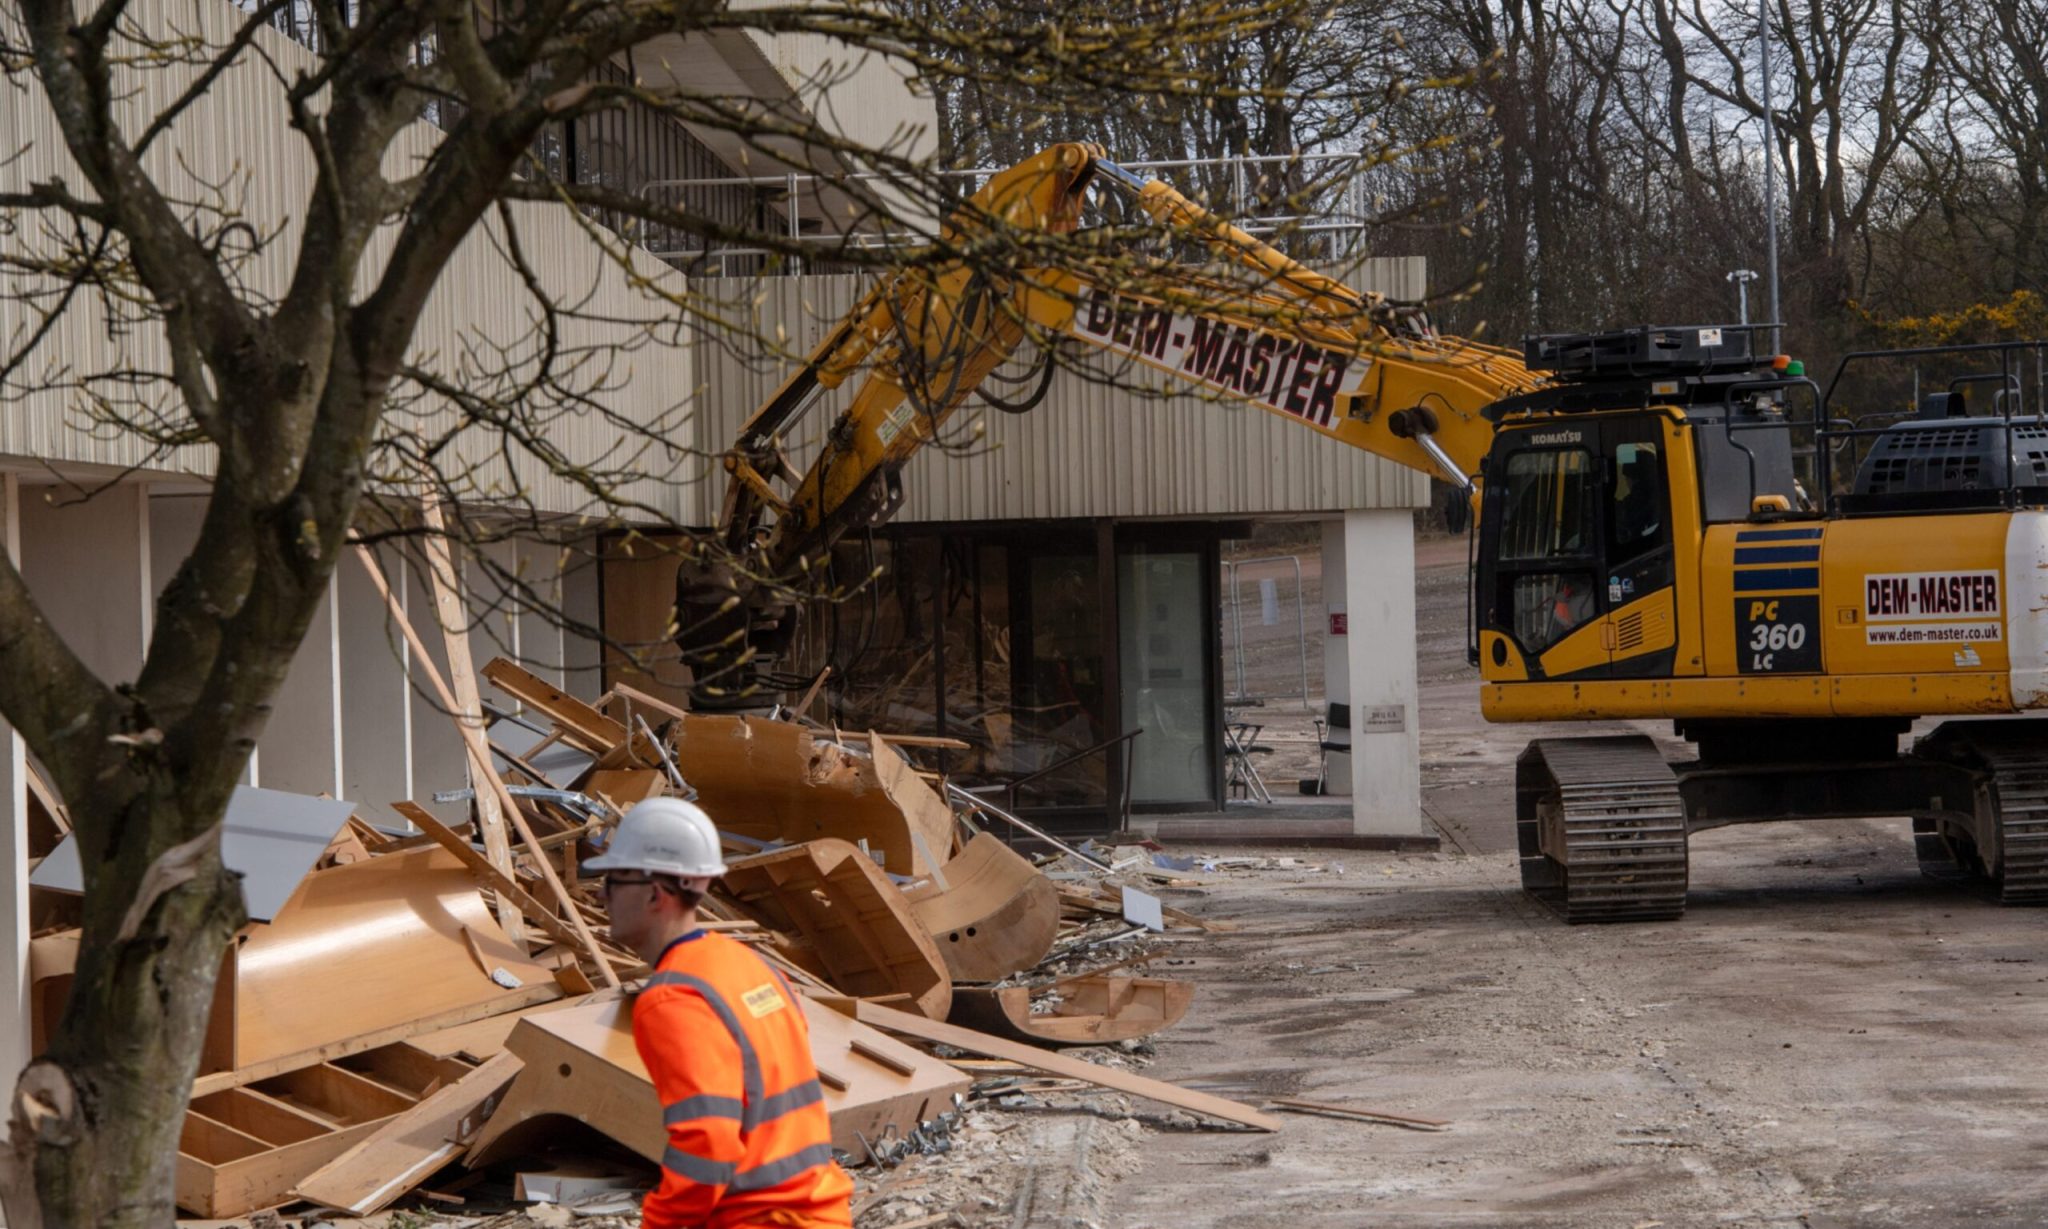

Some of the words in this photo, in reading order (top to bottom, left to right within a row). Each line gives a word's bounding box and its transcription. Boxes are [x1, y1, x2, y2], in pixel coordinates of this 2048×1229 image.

[1531, 430, 1582, 445] KOMATSU
[1867, 575, 1997, 615] DEM-MASTER
[1750, 601, 1779, 621] PC
[1750, 623, 1806, 651] 360
[1869, 624, 1999, 642] www.dem-master.co.uk
[1753, 653, 1774, 670] LC
